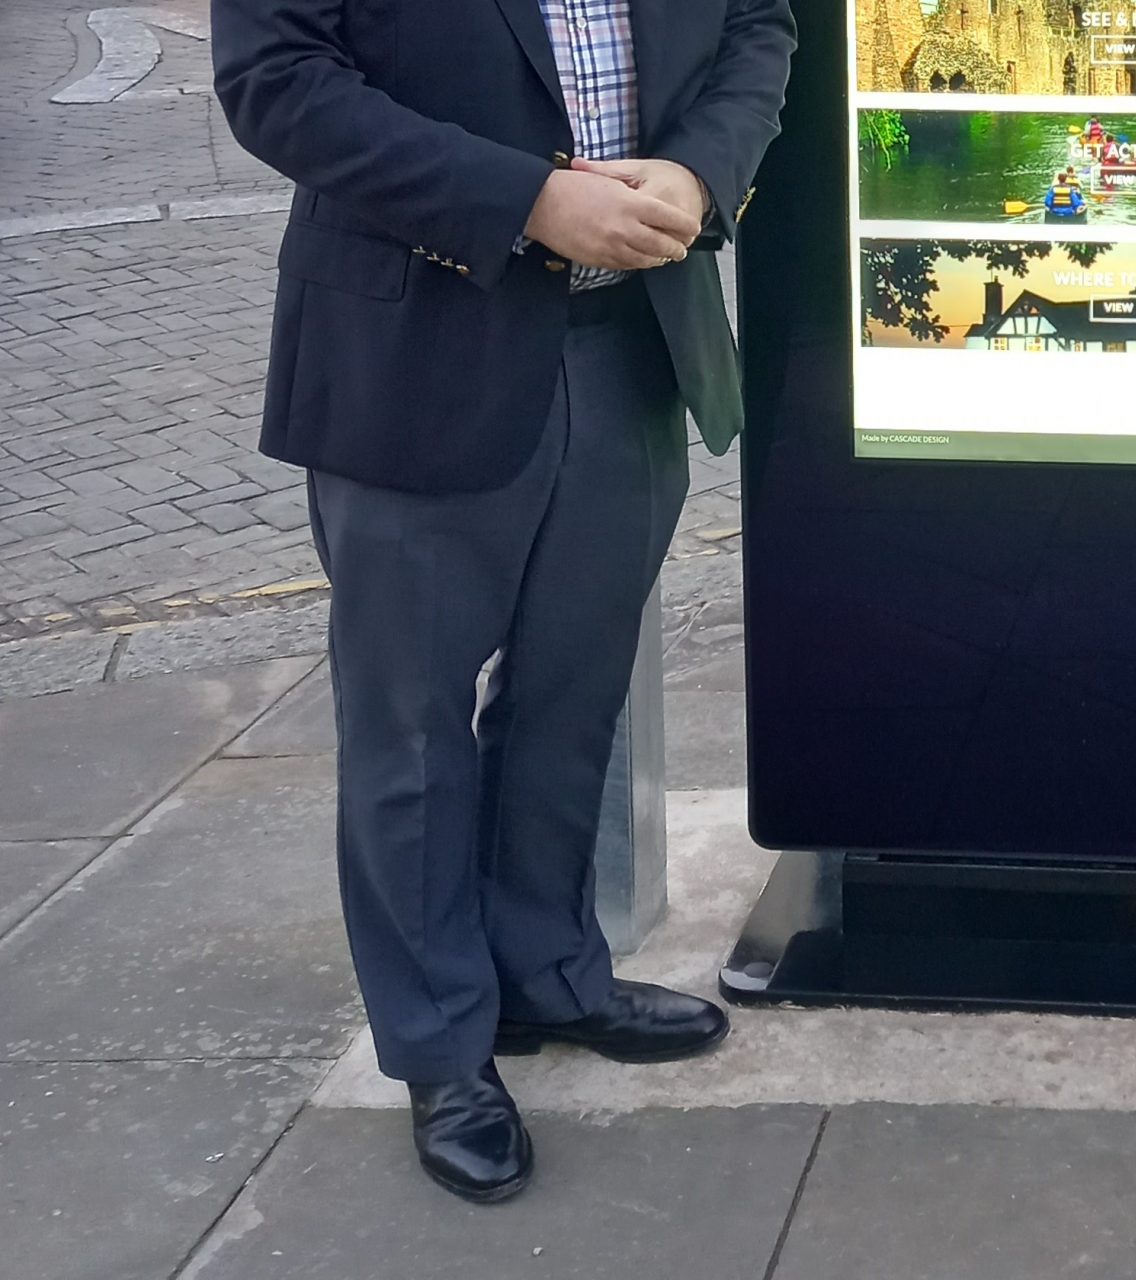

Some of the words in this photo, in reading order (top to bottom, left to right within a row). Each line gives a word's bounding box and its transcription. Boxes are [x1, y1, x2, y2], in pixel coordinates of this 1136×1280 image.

[1081, 11, 1112, 27] SEE
[1115, 12, 1128, 27] &
[1104, 43, 1136, 54] VIEW
[1070, 143, 1104, 158] GET
[1104, 174, 1136, 185] VIEW
[1053, 271, 1114, 286] WHERE
[1103, 301, 1134, 313] VIEW
[861, 434, 880, 442] Made
[880, 434, 889, 444] by
[889, 435, 922, 444] CASCADE
[923, 436, 950, 444] DESIGN
